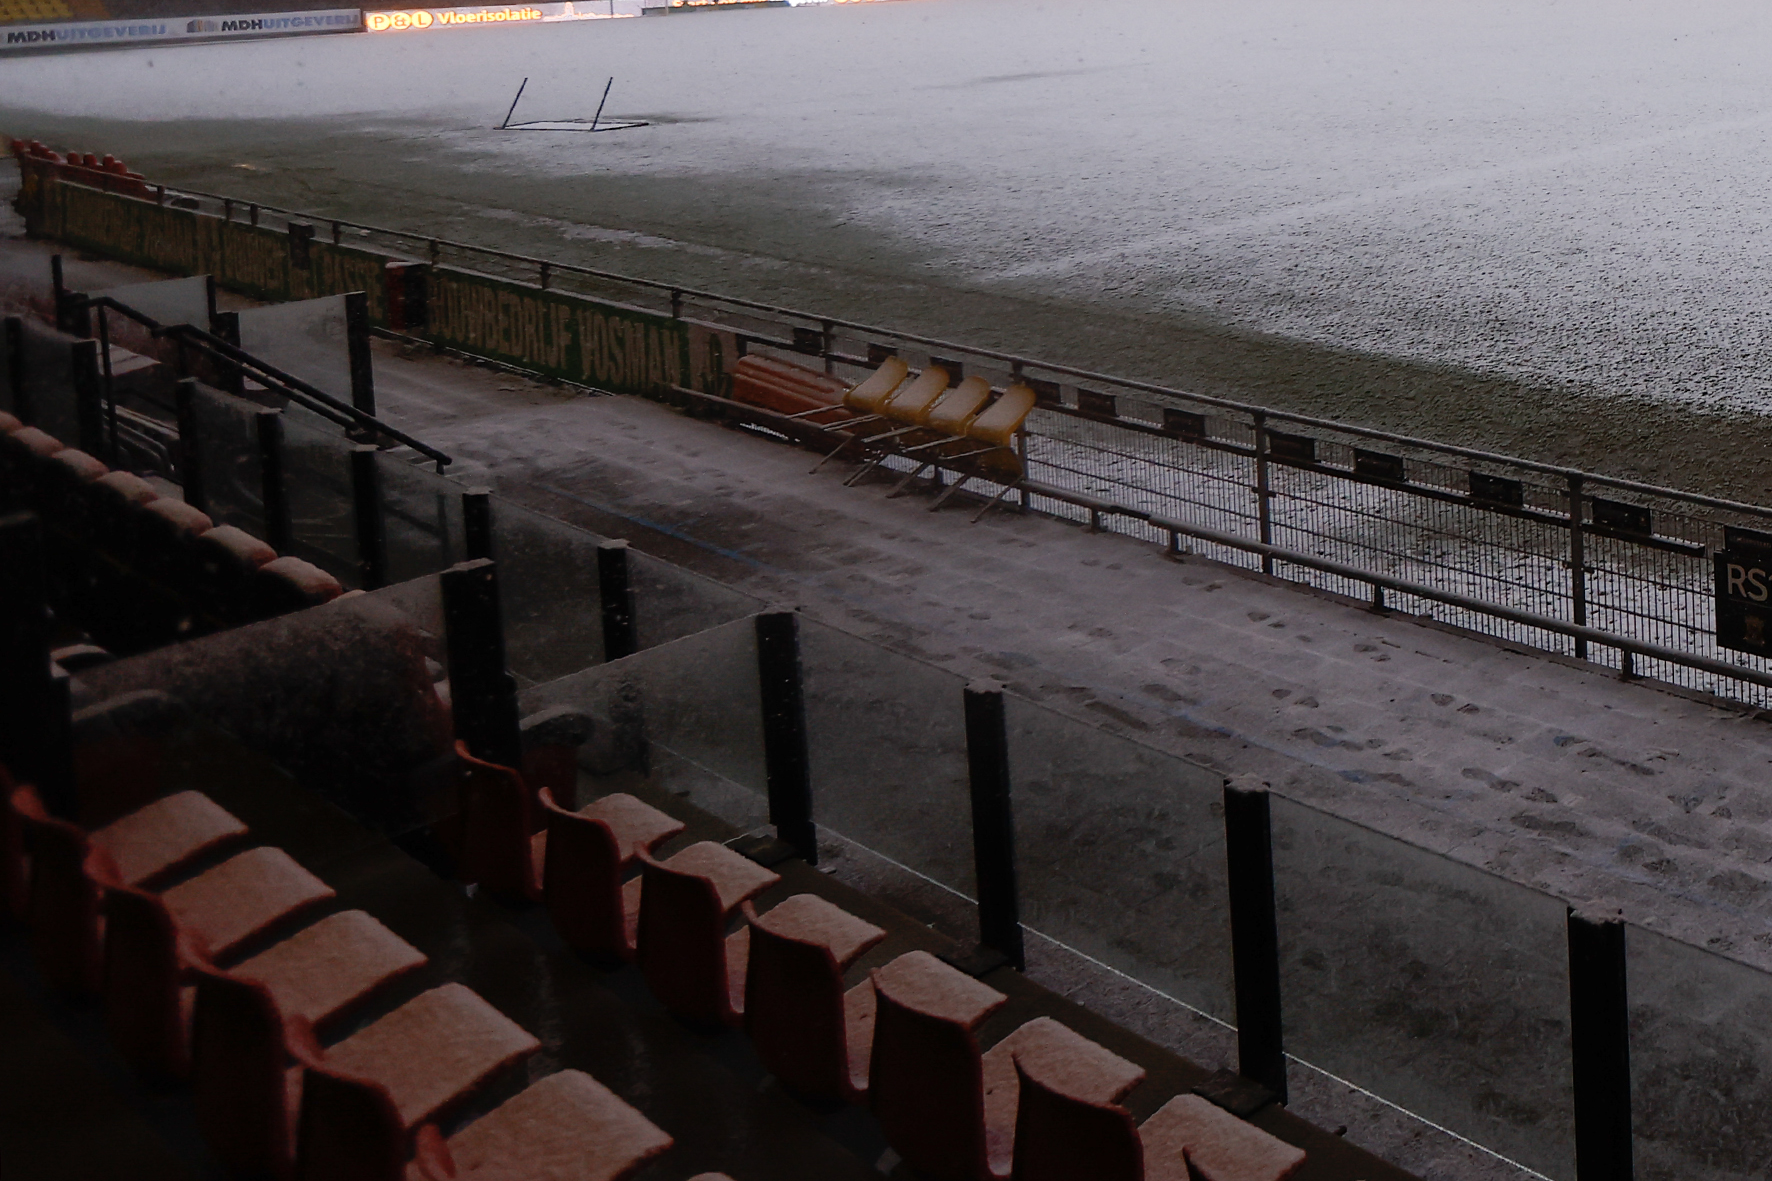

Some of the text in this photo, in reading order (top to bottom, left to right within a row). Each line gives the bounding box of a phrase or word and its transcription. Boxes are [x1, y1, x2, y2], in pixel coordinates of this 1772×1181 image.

[436, 7, 543, 25] Vloerisolatie
[7, 24, 167, 44] MDHUITGEVERIJ
[576, 308, 681, 395] VOSMAN
